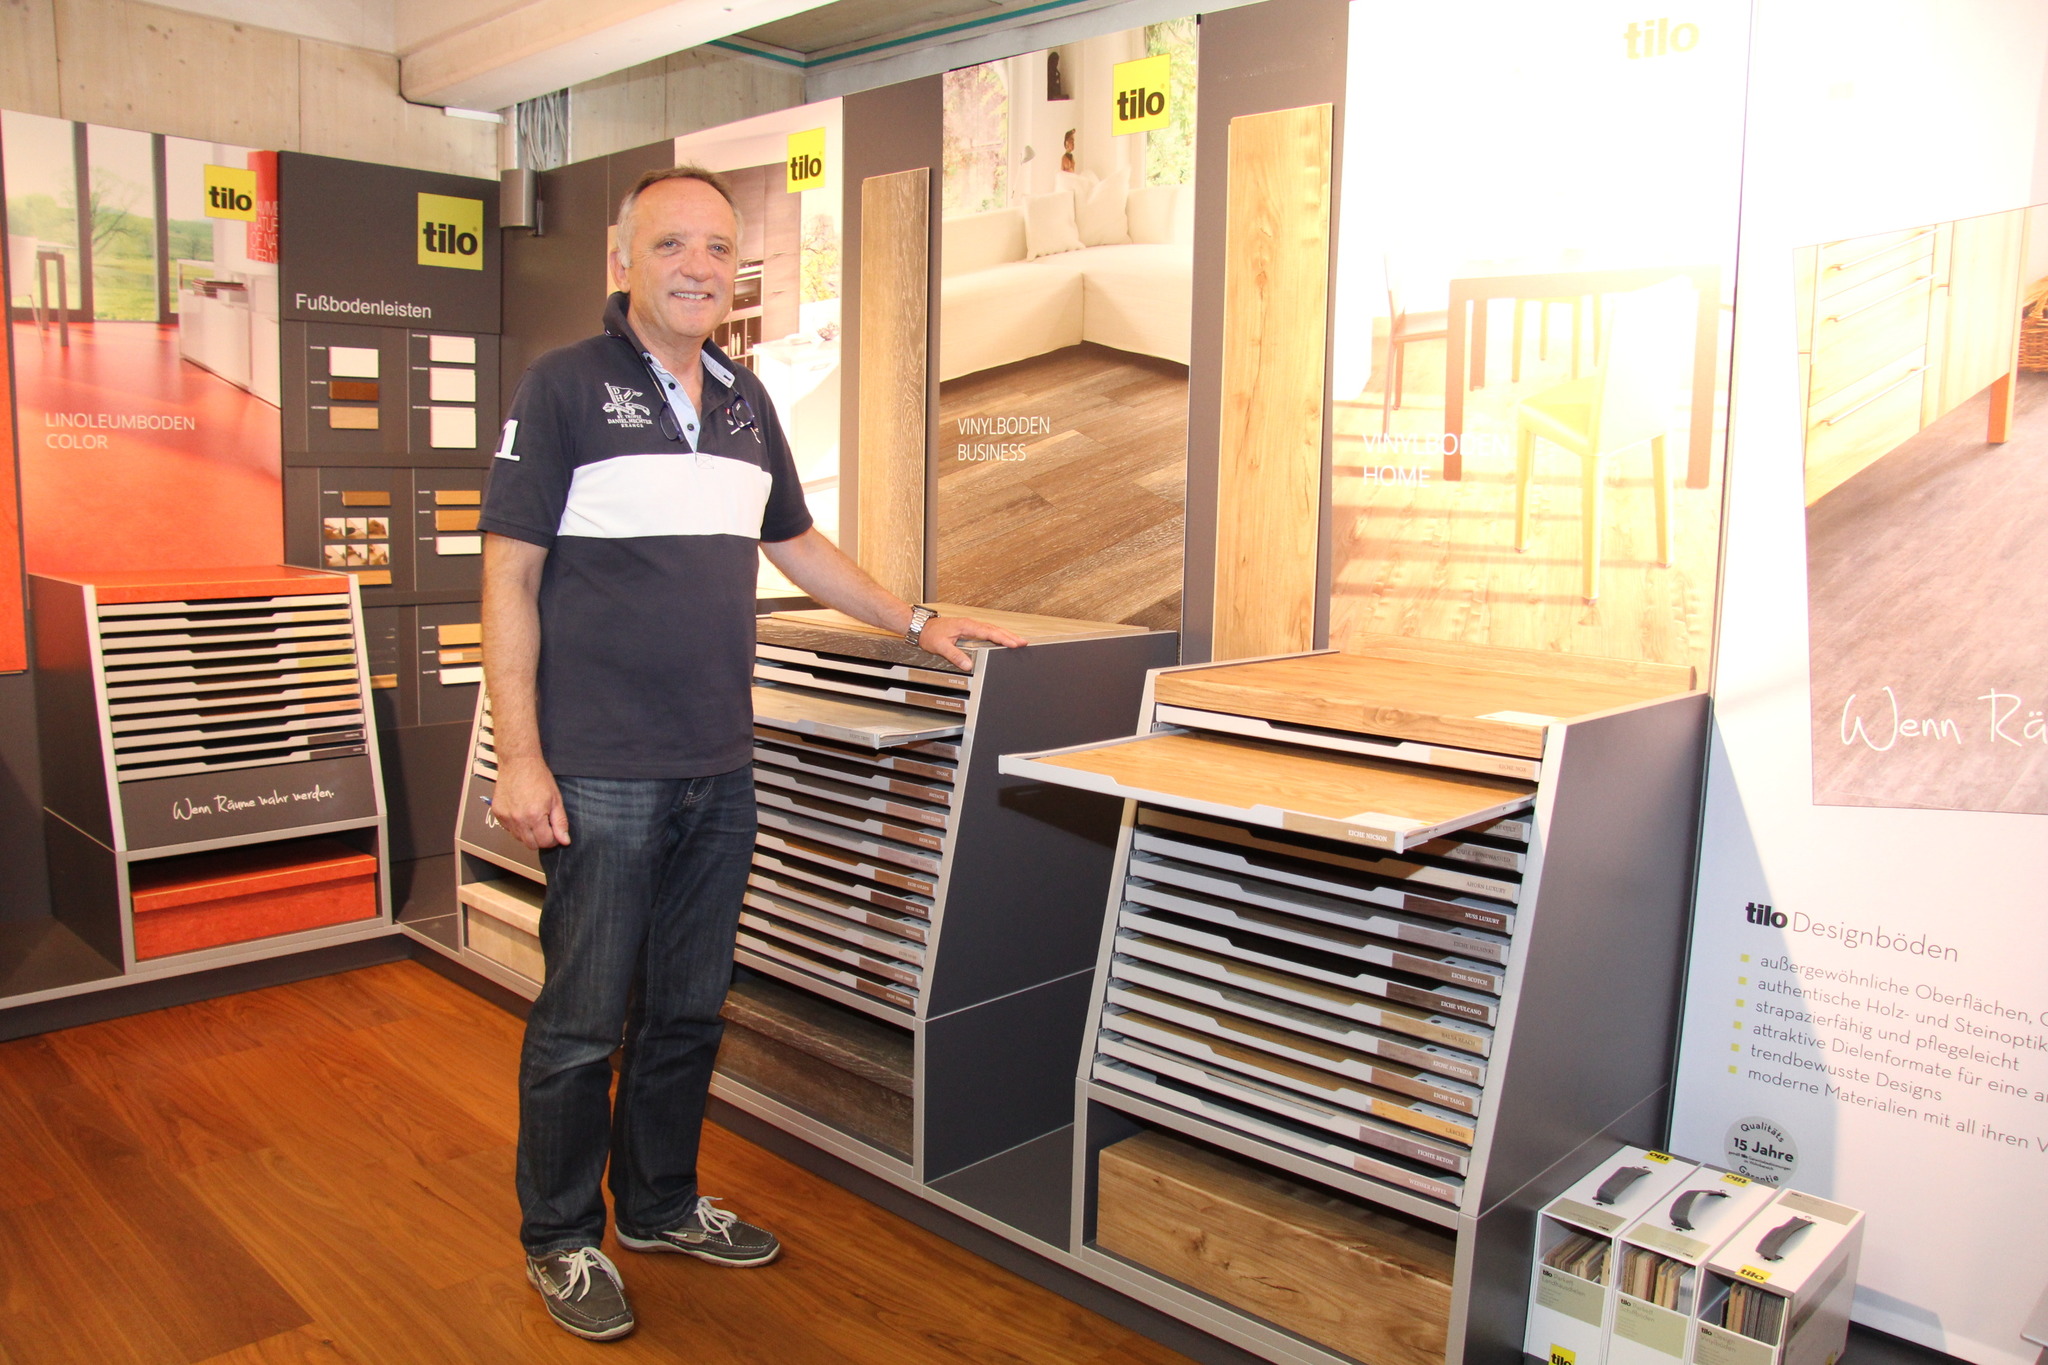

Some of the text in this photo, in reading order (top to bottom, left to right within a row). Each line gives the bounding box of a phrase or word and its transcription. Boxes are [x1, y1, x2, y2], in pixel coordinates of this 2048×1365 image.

[1624, 17, 1700, 59] tilo
[1117, 88, 1165, 122] tilo
[790, 154, 822, 181] tilo
[208, 185, 252, 212] tilo
[423, 221, 478, 255] tilo
[295, 293, 432, 319] Fußbodenleisten
[45, 412, 196, 431] LINOLEUMBODEN
[957, 416, 1050, 435] VINYLBODEN
[46, 433, 108, 449] COLOR
[494, 419, 520, 461] 1
[1362, 432, 1511, 456] VINYLBODEN
[957, 443, 1026, 461] BUSINESS
[1363, 465, 1432, 487] HOME
[1841, 685, 1962, 751] Wenn
[173, 784, 334, 820] Wenn Räume wahr werden.
[1348, 829, 1366, 838] EICHE
[1466, 881, 1506, 894] AHORN LUXURY
[1465, 912, 1500, 924] NUSS LUXURY
[1745, 902, 1959, 963] tilo Designböden
[1453, 941, 1469, 950] EICHE
[1451, 972, 1488, 986] EICHE SCOTCH
[1760, 955, 1909, 996] außergewöhnliche
[1915, 984, 2033, 1025] Oberflächen,
[1440, 1001, 1482, 1016] EICHE VULCANO
[1758, 980, 1861, 1010] authentische
[1866, 998, 1910, 1020] Holz-
[1916, 1014, 1949, 1029] und
[1954, 1016, 2048, 1053] Steinoptik
[1755, 1001, 2020, 1072] strapazierfähig und pflegeleicht
[1753, 1024, 1826, 1049] attraktive
[1832, 1037, 1952, 1079] Dielenformate
[1958, 1067, 1983, 1087] für
[1988, 1079, 2028, 1098] eine
[1751, 1044, 1942, 1101] trendbewusste Designs
[1434, 1092, 1450, 1101] EICHE
[1748, 1070, 1819, 1095] moderne
[1825, 1083, 1917, 1120] Materialien
[1923, 1111, 1950, 1129] mit
[1955, 1118, 1975, 1135] all
[1981, 1124, 2029, 1149] ihren
[1740, 1121, 1785, 1143] Qualitäts
[1417, 1149, 1454, 1165] FICHTE BETON
[1733, 1137, 1748, 1151] 15
[1751, 1141, 1794, 1163] Jahre
[1542, 1269, 1553, 1277] tilo
[1740, 1268, 1765, 1281] tilo
[1620, 1298, 1632, 1307] tilo
[1701, 1327, 1713, 1336] tilo
[1551, 1353, 1572, 1365] tilo
